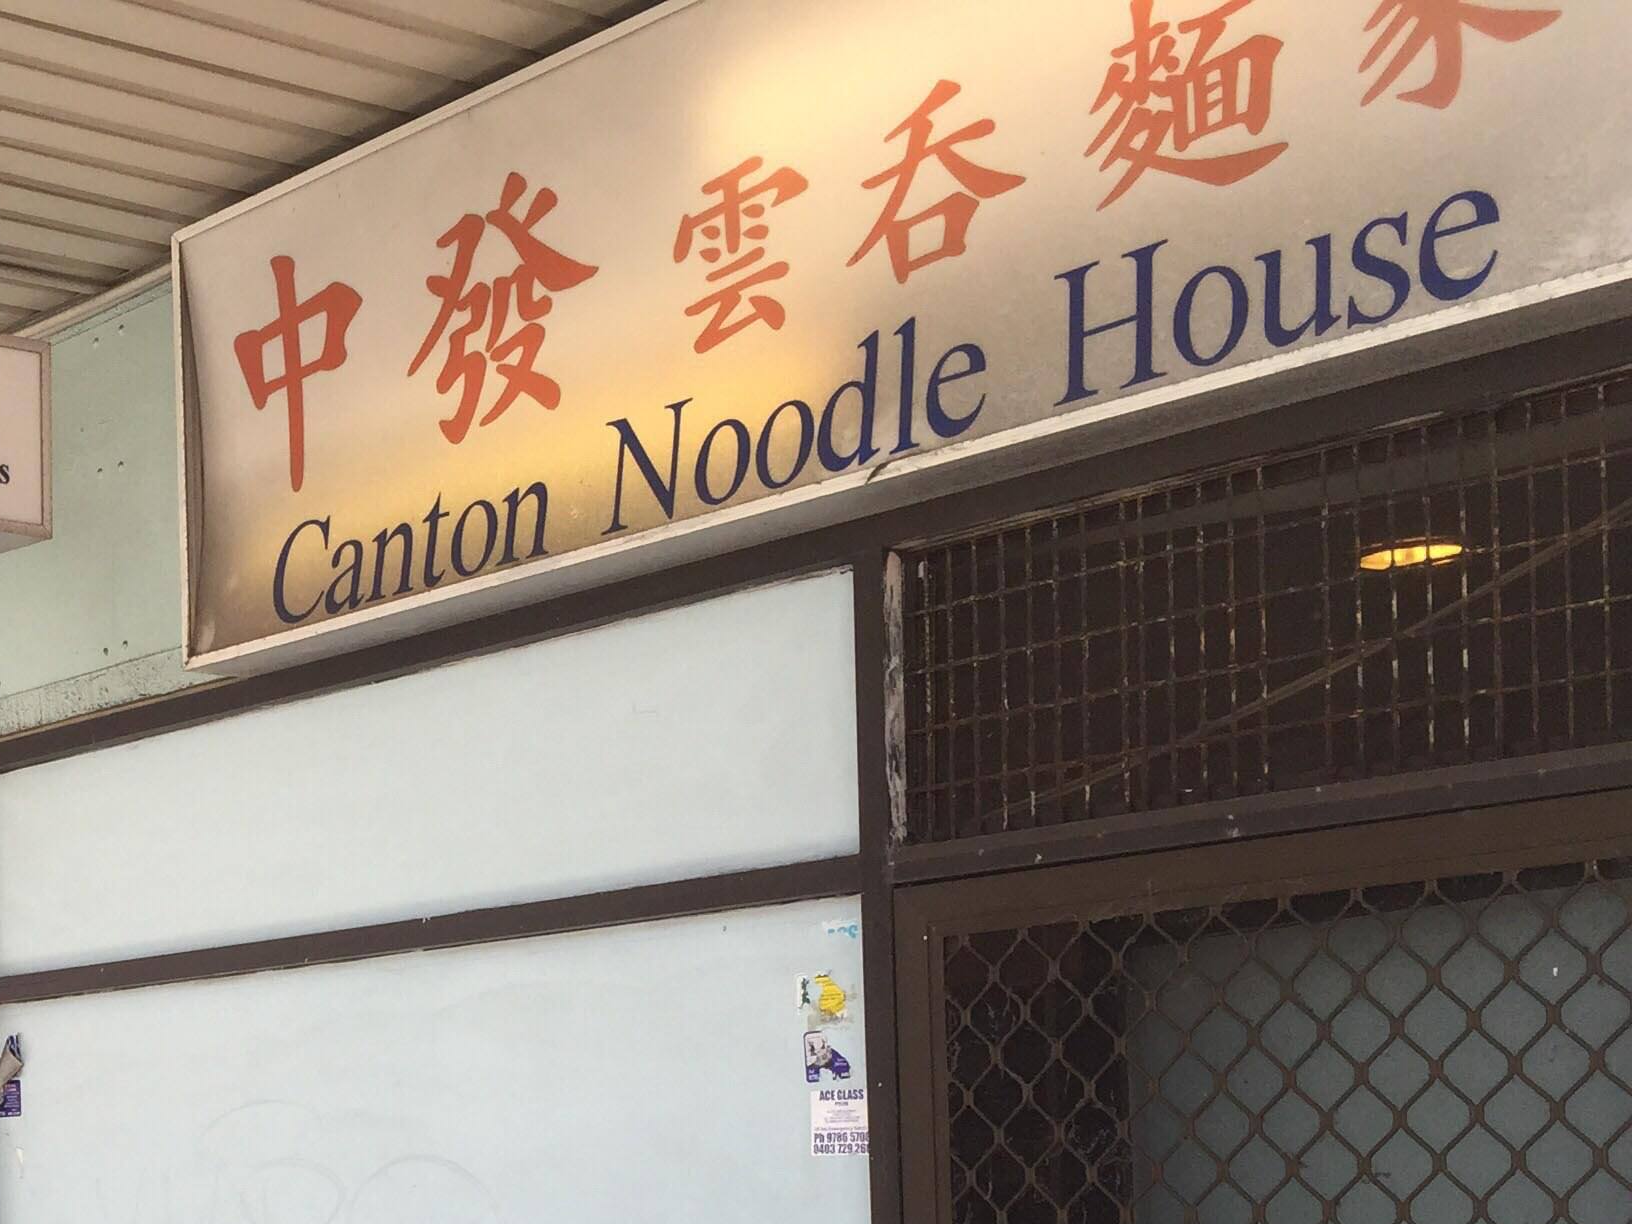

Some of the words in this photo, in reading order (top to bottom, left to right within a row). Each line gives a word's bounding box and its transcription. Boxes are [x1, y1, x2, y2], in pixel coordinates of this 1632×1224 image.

[272, 475, 550, 627] Canton
[603, 316, 988, 535] Noodle
[1052, 187, 1502, 405] House
[819, 1089, 836, 1101] ACE
[837, 1088, 864, 1101] GLASS
